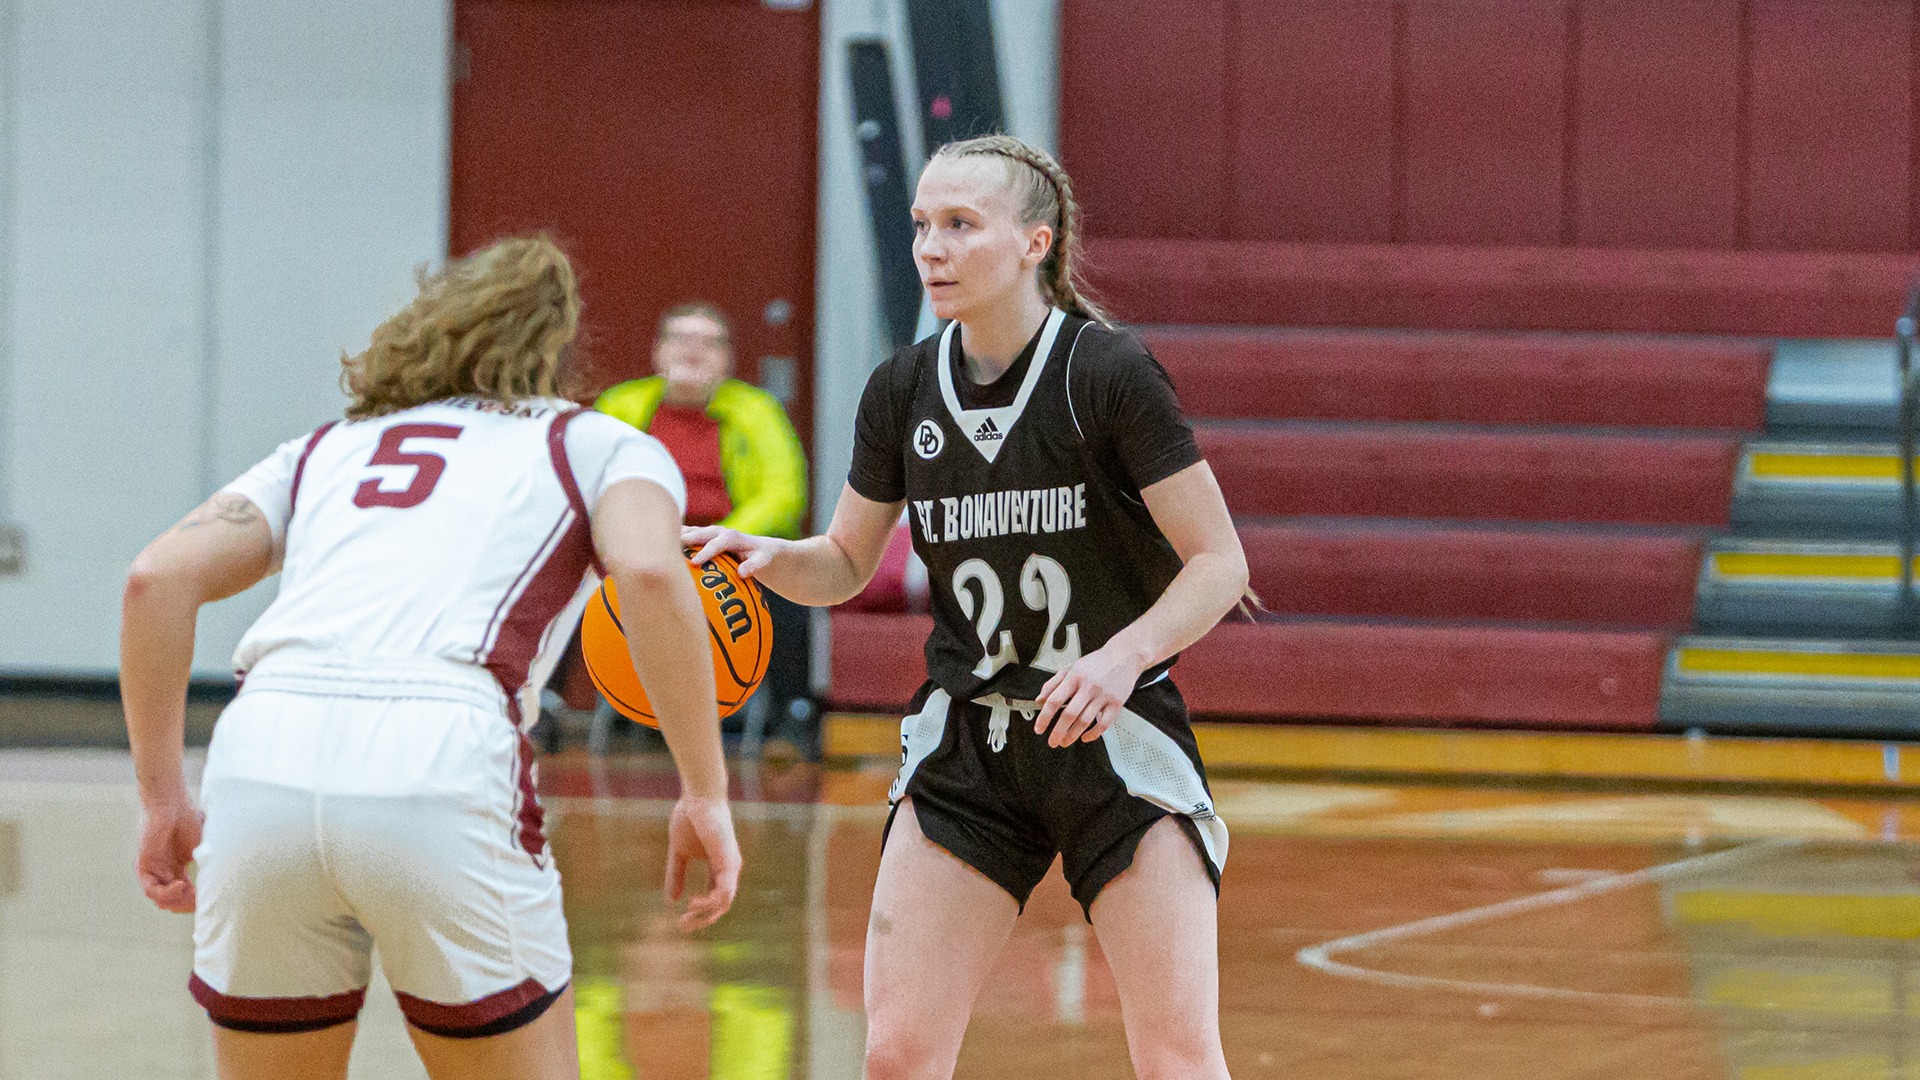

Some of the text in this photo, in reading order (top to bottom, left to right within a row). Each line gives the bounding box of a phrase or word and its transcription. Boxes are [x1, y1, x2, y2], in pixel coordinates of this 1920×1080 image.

[353, 422, 465, 509] 5
[974, 432, 1003, 441] adidas
[940, 483, 1086, 542] BONAVENTURE
[952, 553, 1082, 680] 22
